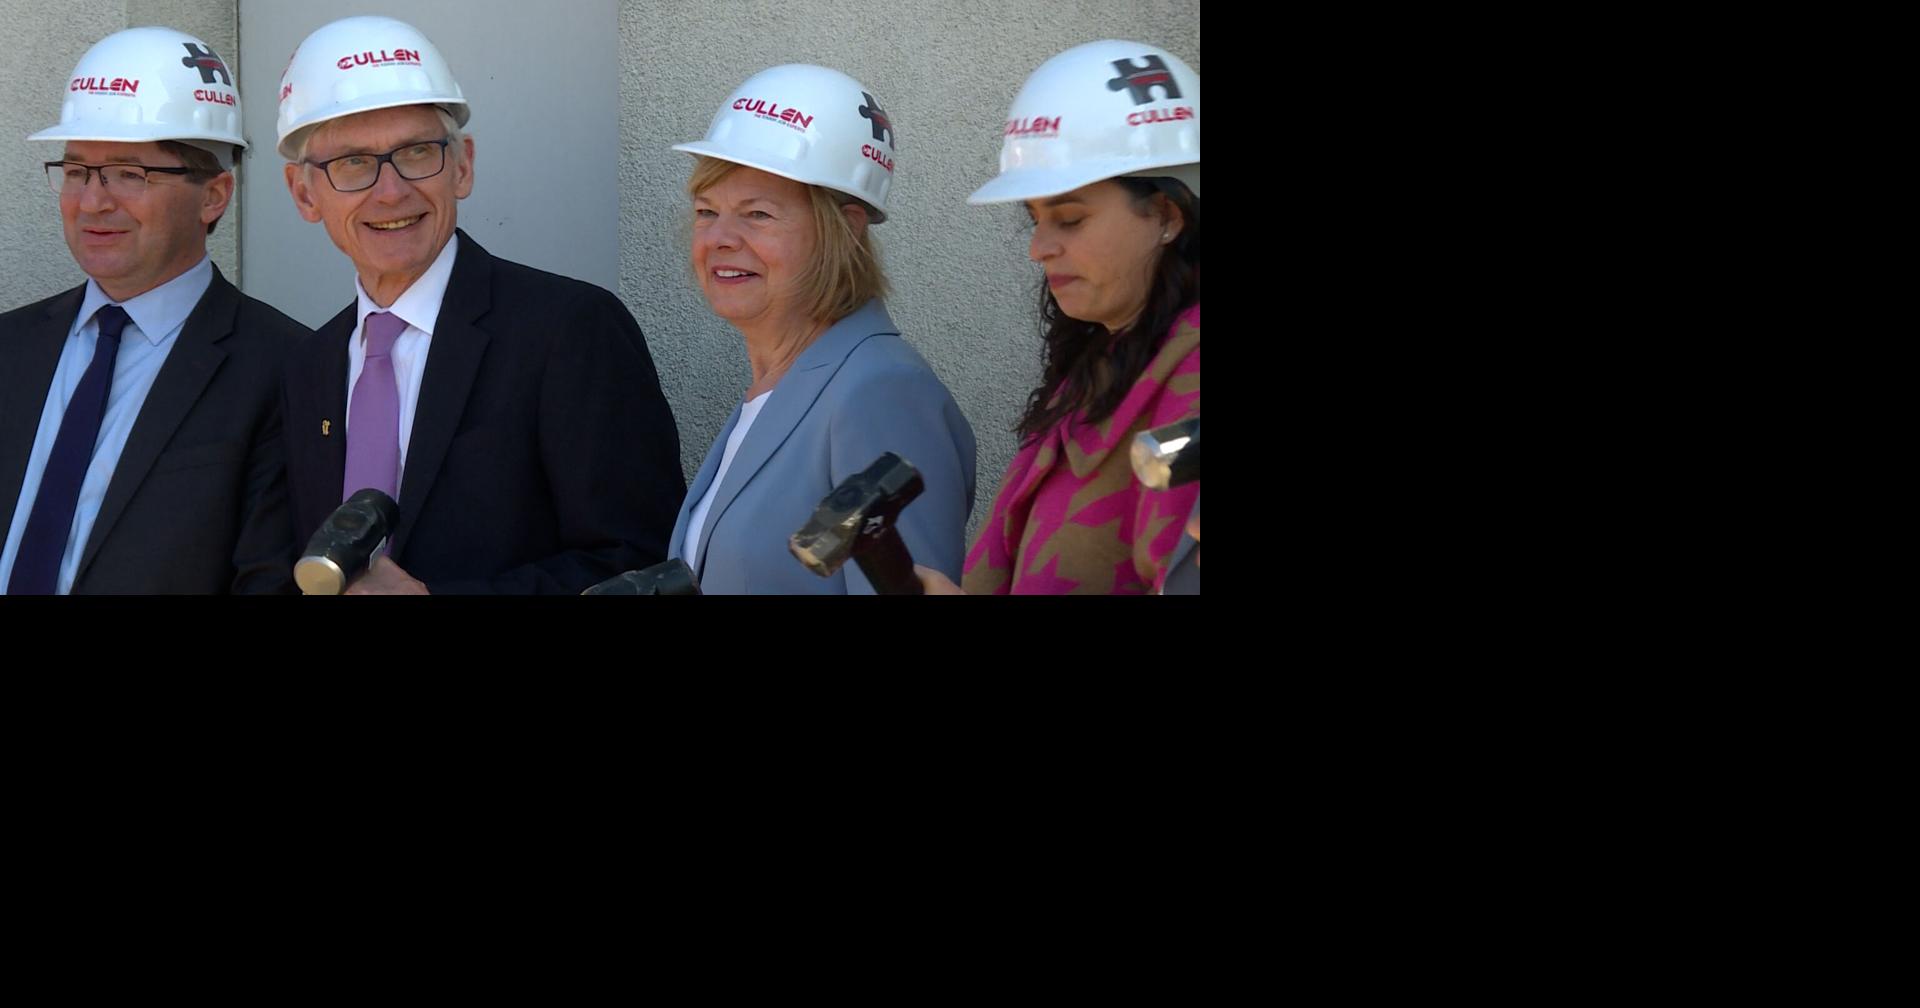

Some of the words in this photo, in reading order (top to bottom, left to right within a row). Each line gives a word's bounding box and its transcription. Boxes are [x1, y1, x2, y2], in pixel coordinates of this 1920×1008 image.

[336, 48, 420, 70] CULLEN
[70, 77, 139, 93] CULLEN
[732, 97, 814, 129] CULLEN
